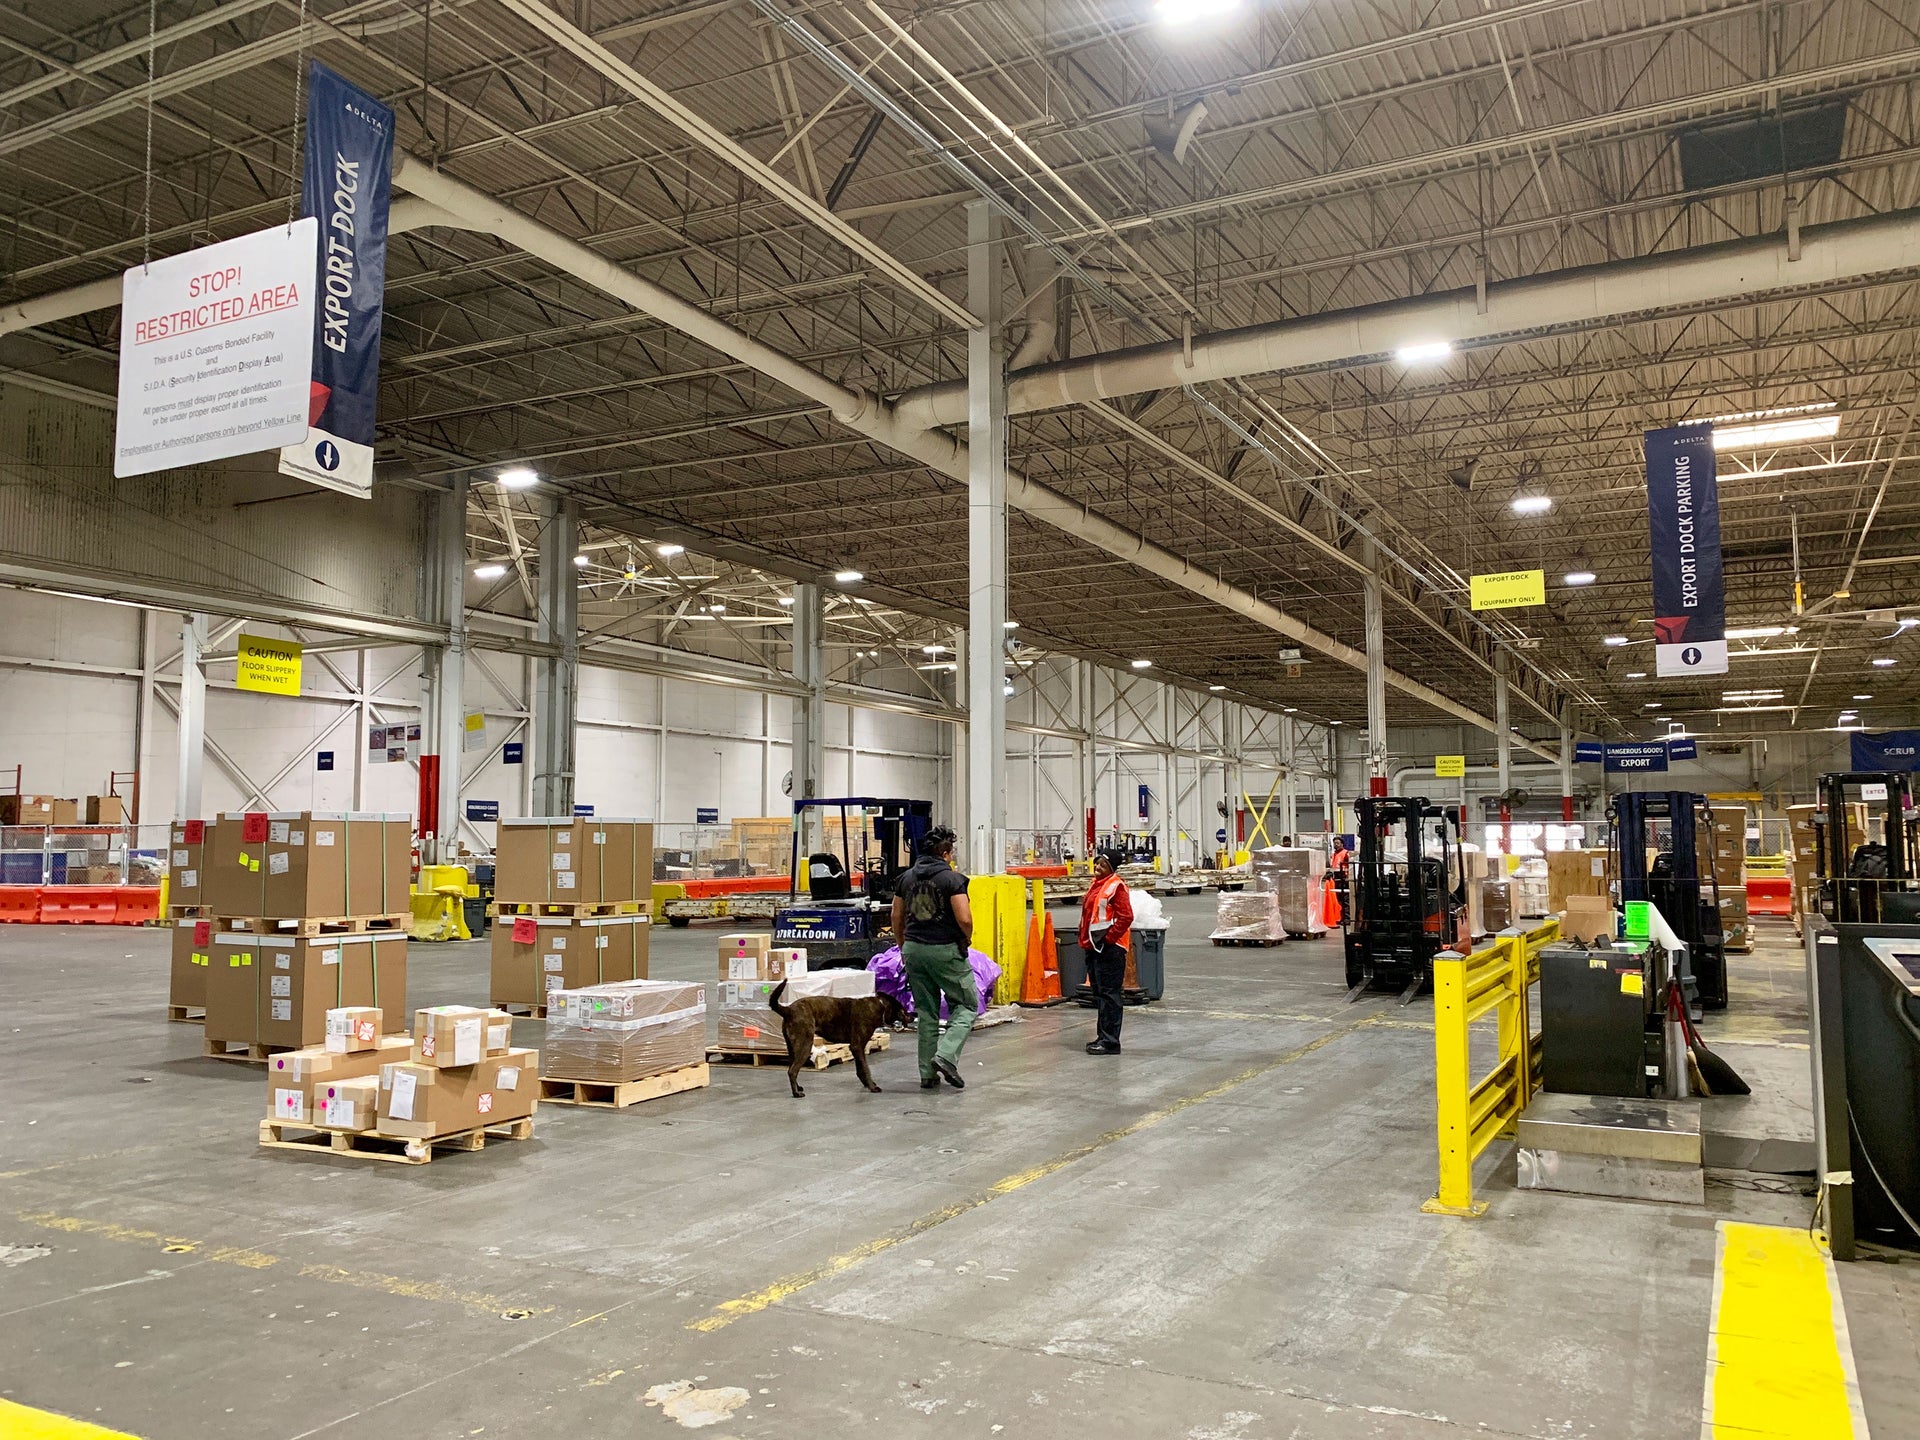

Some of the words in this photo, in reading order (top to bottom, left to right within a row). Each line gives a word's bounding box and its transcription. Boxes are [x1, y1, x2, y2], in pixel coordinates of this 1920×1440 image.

[354, 107, 382, 129] DELTA
[331, 151, 359, 236] DOCK
[189, 266, 241, 298] STOP!
[323, 236, 354, 353] EXPORT
[135, 297, 244, 342] RESTRICTED
[248, 283, 298, 314] AREA
[153, 355, 166, 365] This
[180, 349, 193, 359] U.S.
[195, 342, 223, 356] Customs
[225, 337, 250, 350] Bonded
[251, 330, 275, 343] Facility
[196, 364, 237, 382] Identification
[238, 357, 263, 372] Display
[264, 352, 284, 367] Area)
[205, 356, 218, 366] and
[142, 406, 151, 416] All
[151, 402, 177, 415] persons
[177, 398, 193, 411] must
[194, 393, 217, 405] display
[217, 389, 239, 401] proper
[240, 379, 282, 395] identification
[152, 418, 159, 426] or
[160, 415, 168, 424] be
[169, 411, 188, 422] under
[188, 407, 210, 420] proper
[211, 402, 231, 414] escort
[231, 401, 239, 409] at
[240, 398, 248, 408] all
[154, 441, 161, 450] or
[161, 434, 199, 449] Authorized
[196, 430, 221, 443] persons
[222, 424, 236, 437] only
[237, 420, 262, 434] beyond
[263, 416, 285, 428] Yellow
[1680, 436, 1705, 444] DELTA
[1675, 456, 1693, 513] PARKING
[1678, 516, 1695, 554] DOCK
[1484, 575, 1509, 583] EXPORT
[1680, 556, 1698, 608] EXPORT
[1480, 597, 1517, 606] EQUIPMENT
[247, 646, 293, 661] CAUTION
[242, 661, 265, 671] FLOOR
[265, 665, 297, 675] SLIPPERY
[249, 673, 271, 682] WHEN
[1607, 747, 1642, 755] DANGEROUS
[1643, 746, 1664, 754] GOODS
[1620, 758, 1651, 767] EXPORT
[1883, 747, 1915, 756] SCRUB
[848, 916, 863, 934] 57
